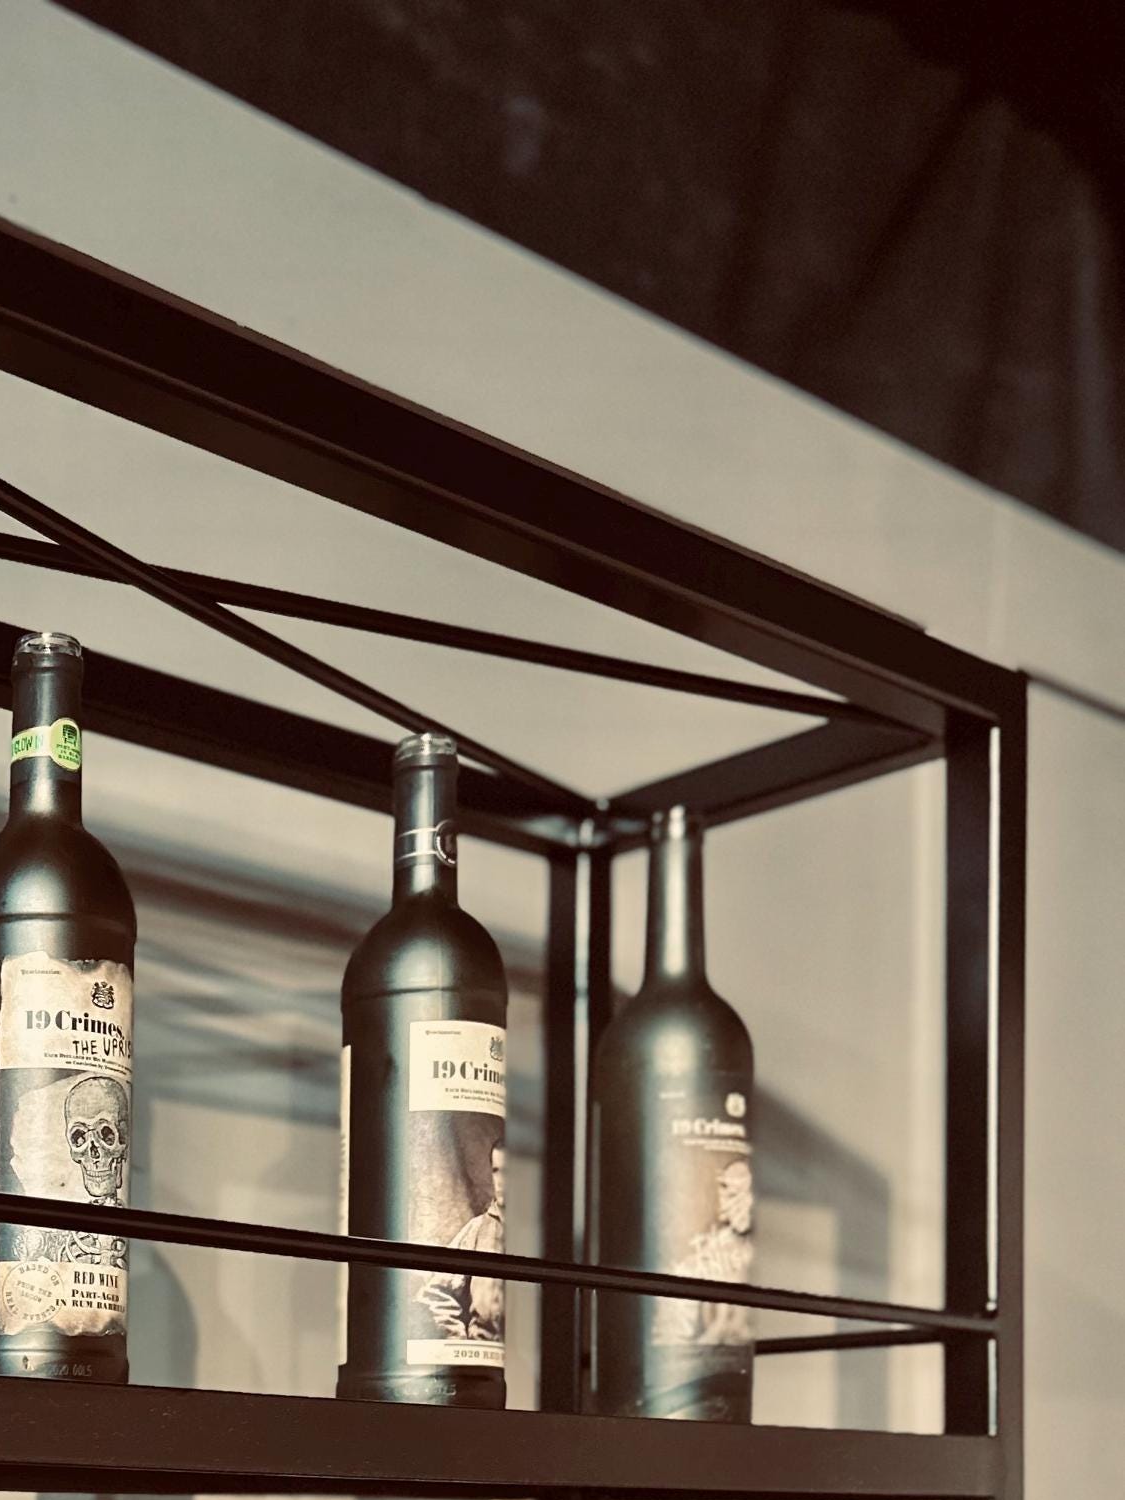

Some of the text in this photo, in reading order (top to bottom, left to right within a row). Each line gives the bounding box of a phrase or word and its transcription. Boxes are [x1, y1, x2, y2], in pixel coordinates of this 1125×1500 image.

[26, 1009, 51, 1030] 19
[72, 1039, 97, 1056] THE
[432, 1060, 456, 1079] 19
[74, 1270, 119, 1290] RED WINE
[55, 1299, 67, 1307] IN
[72, 1299, 93, 1309] RUM
